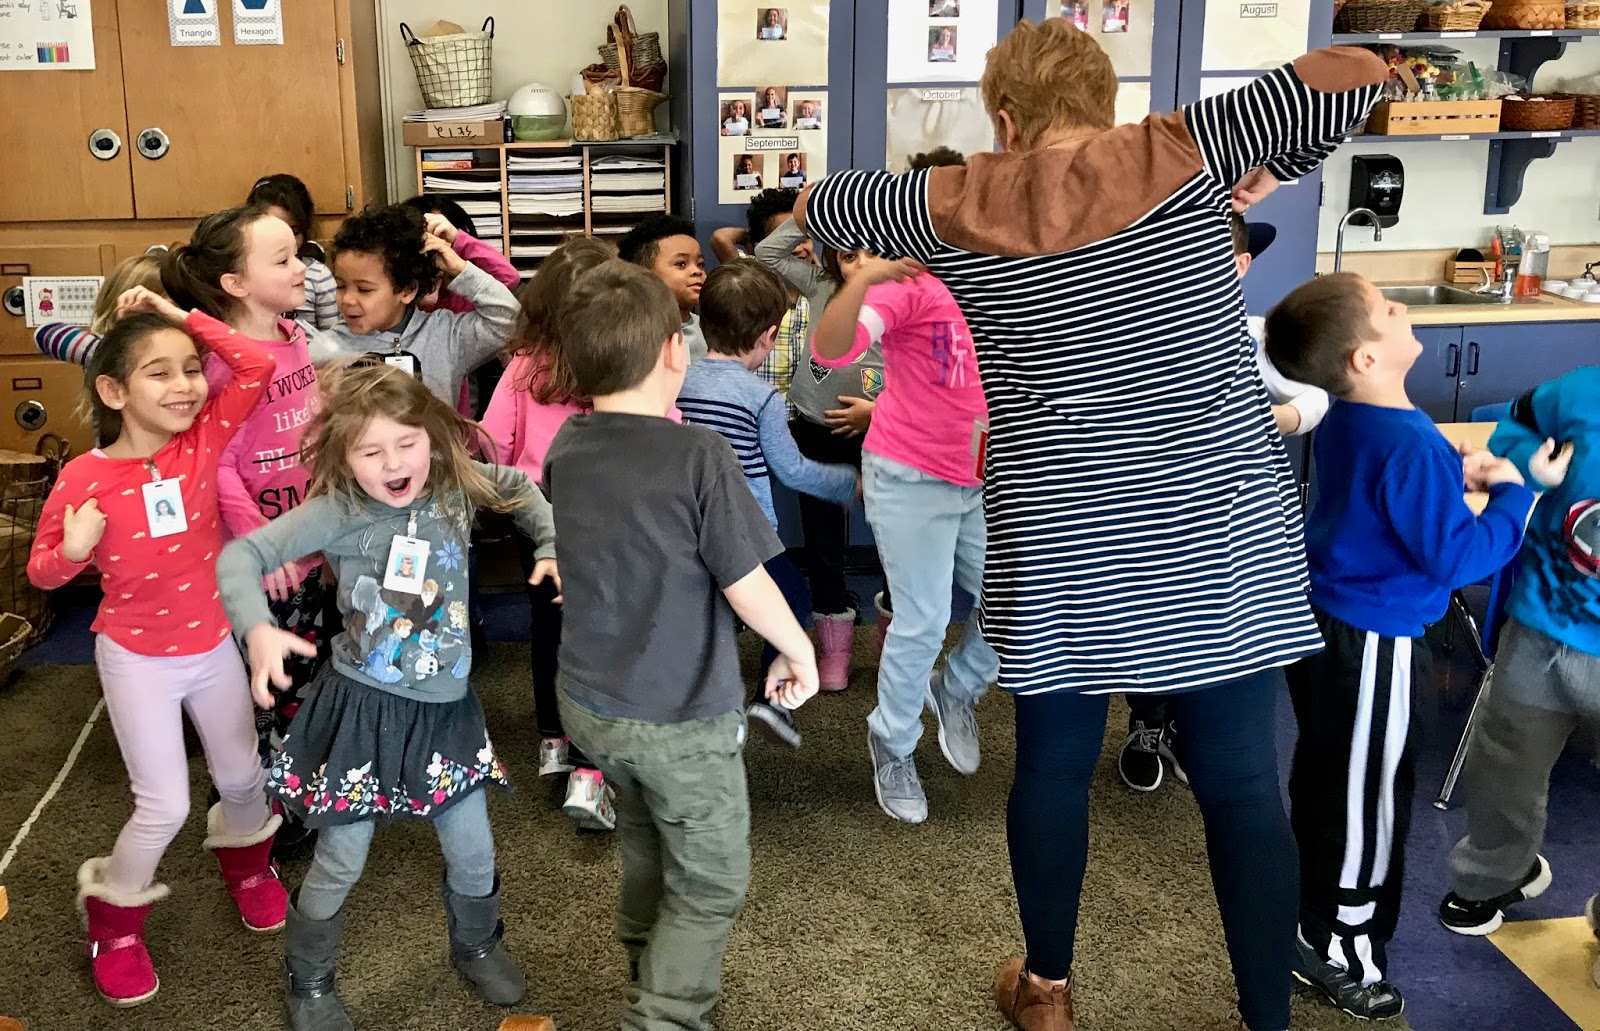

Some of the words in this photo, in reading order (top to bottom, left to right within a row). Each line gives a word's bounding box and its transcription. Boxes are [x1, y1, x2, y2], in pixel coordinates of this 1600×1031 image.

[1242, 4, 1275, 17] August
[179, 29, 213, 38] Triangle
[240, 28, 273, 36] Hexagon
[923, 90, 960, 99] October
[747, 138, 796, 149] September
[265, 385, 275, 405] I
[272, 364, 316, 397] WOKE
[272, 407, 311, 433] like
